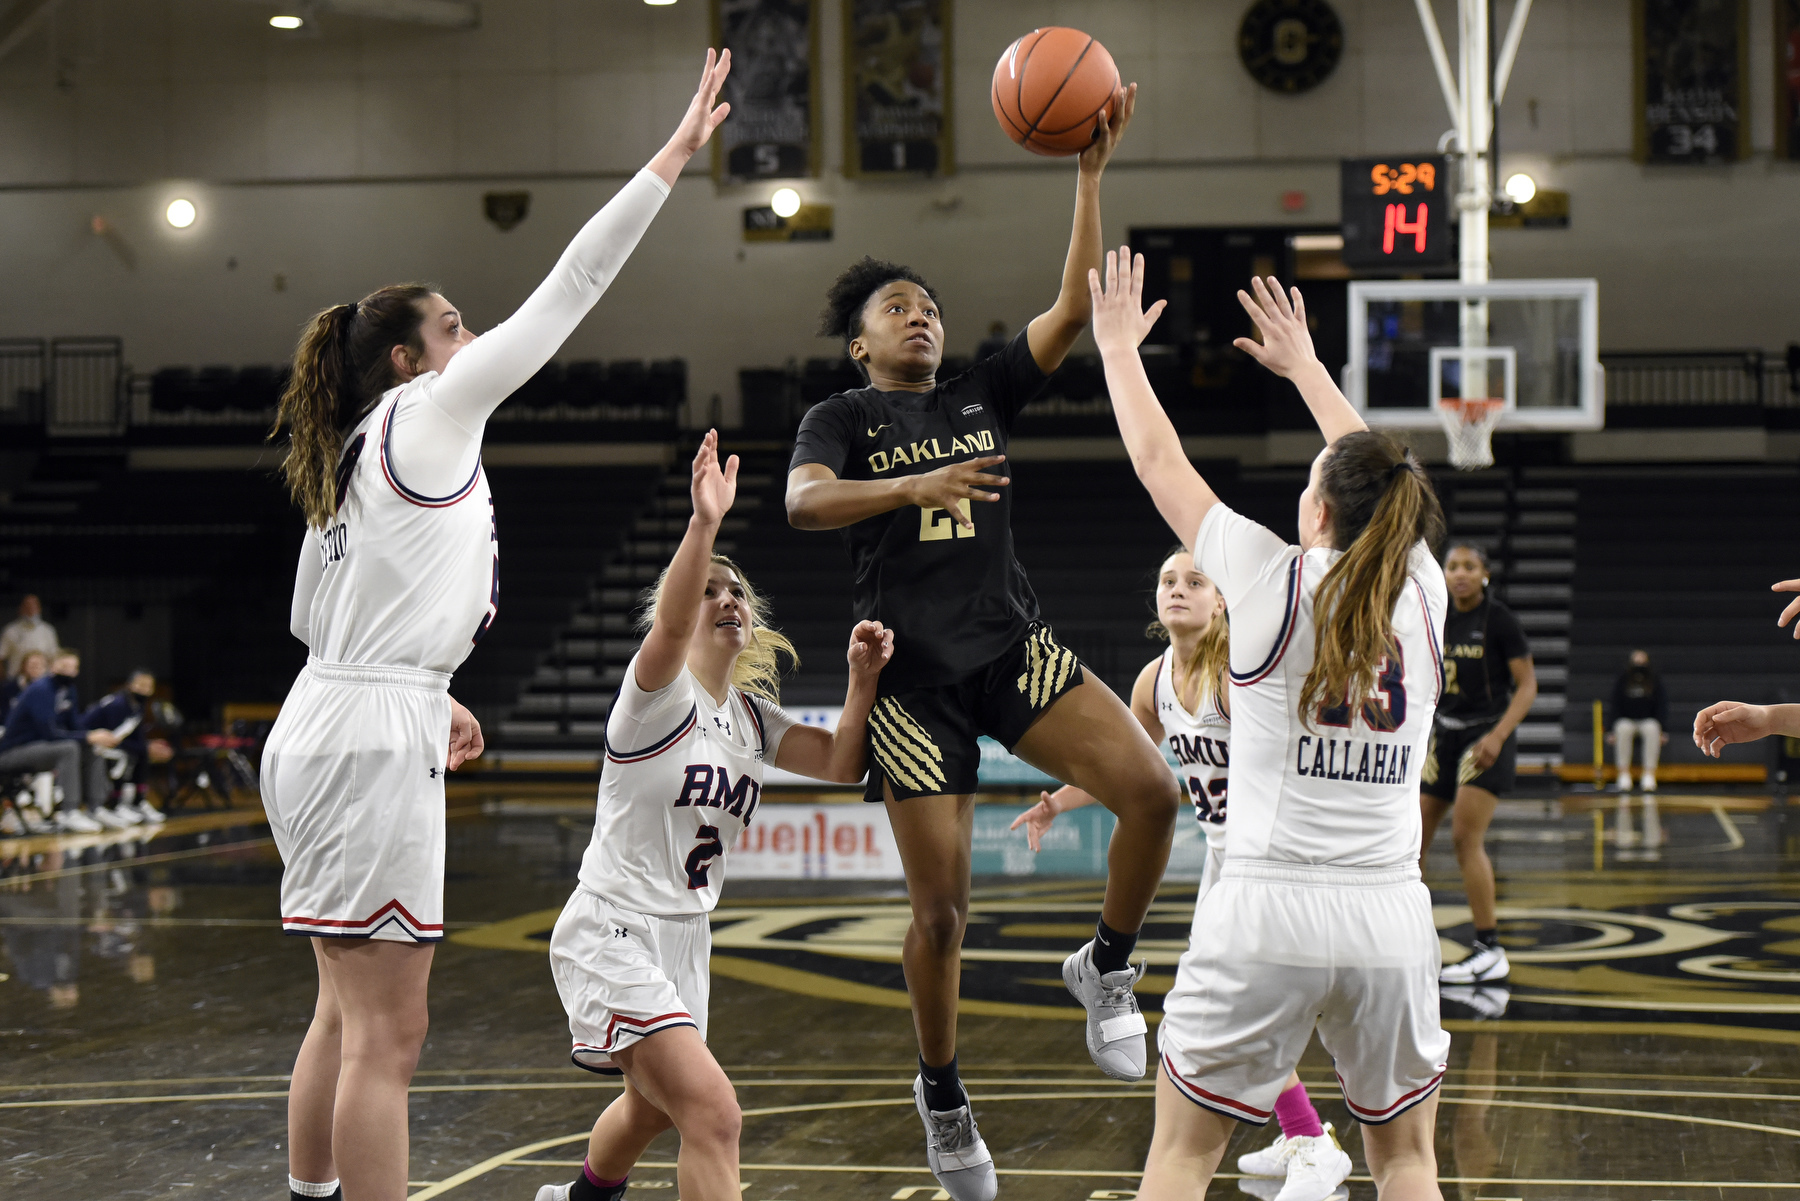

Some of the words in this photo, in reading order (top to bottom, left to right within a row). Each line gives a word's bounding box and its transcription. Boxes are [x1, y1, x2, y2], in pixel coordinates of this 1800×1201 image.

[892, 142, 906, 169] 1
[1666, 124, 1717, 155] 34
[752, 144, 780, 174] 5
[1371, 162, 1436, 196] 5:29
[1382, 202, 1429, 255] 14
[868, 429, 995, 473] OAKLAND
[1169, 734, 1229, 768] RMU
[1297, 735, 1411, 784] CALLAHAN
[685, 824, 723, 889] 2
